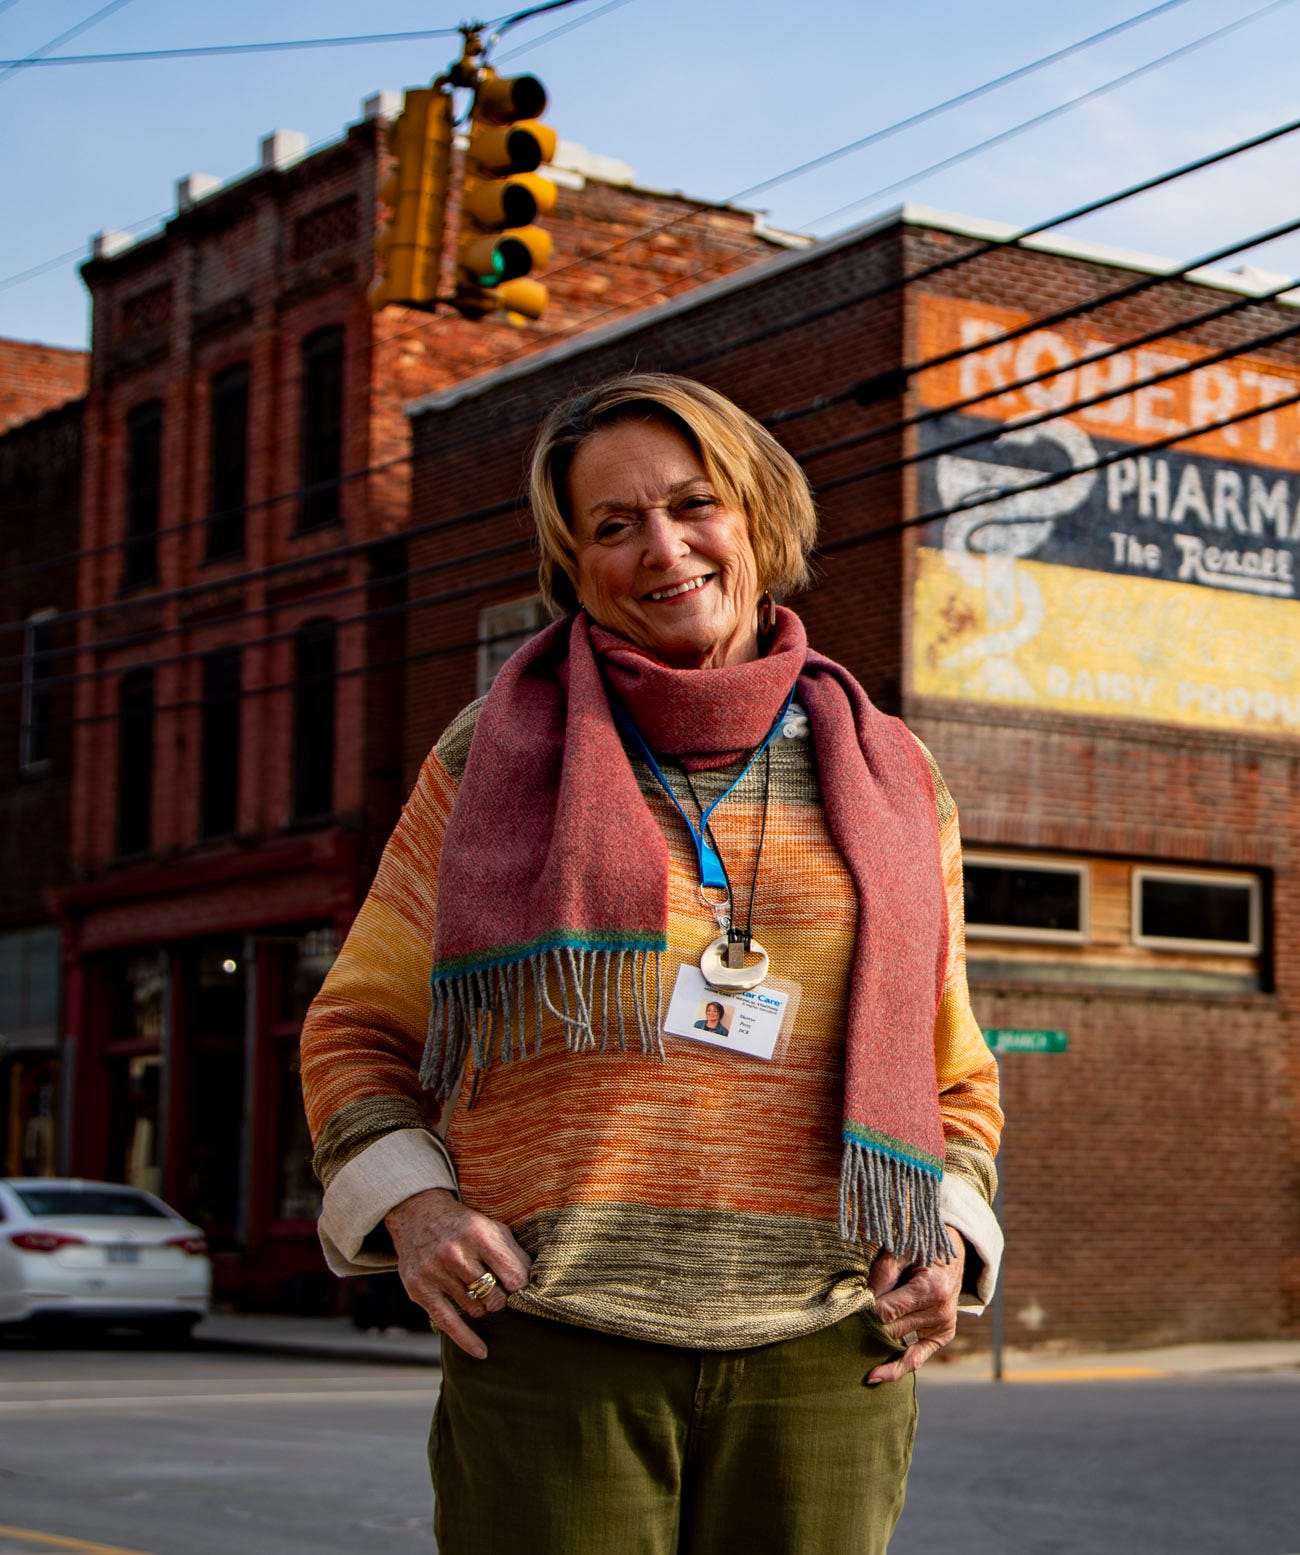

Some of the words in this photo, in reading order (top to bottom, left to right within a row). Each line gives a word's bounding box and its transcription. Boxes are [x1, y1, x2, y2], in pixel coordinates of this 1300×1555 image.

[1110, 531, 1161, 570] The
[1174, 533, 1294, 596] Rexall
[1047, 664, 1156, 706] DAIRY
[757, 994, 780, 1007] Care
